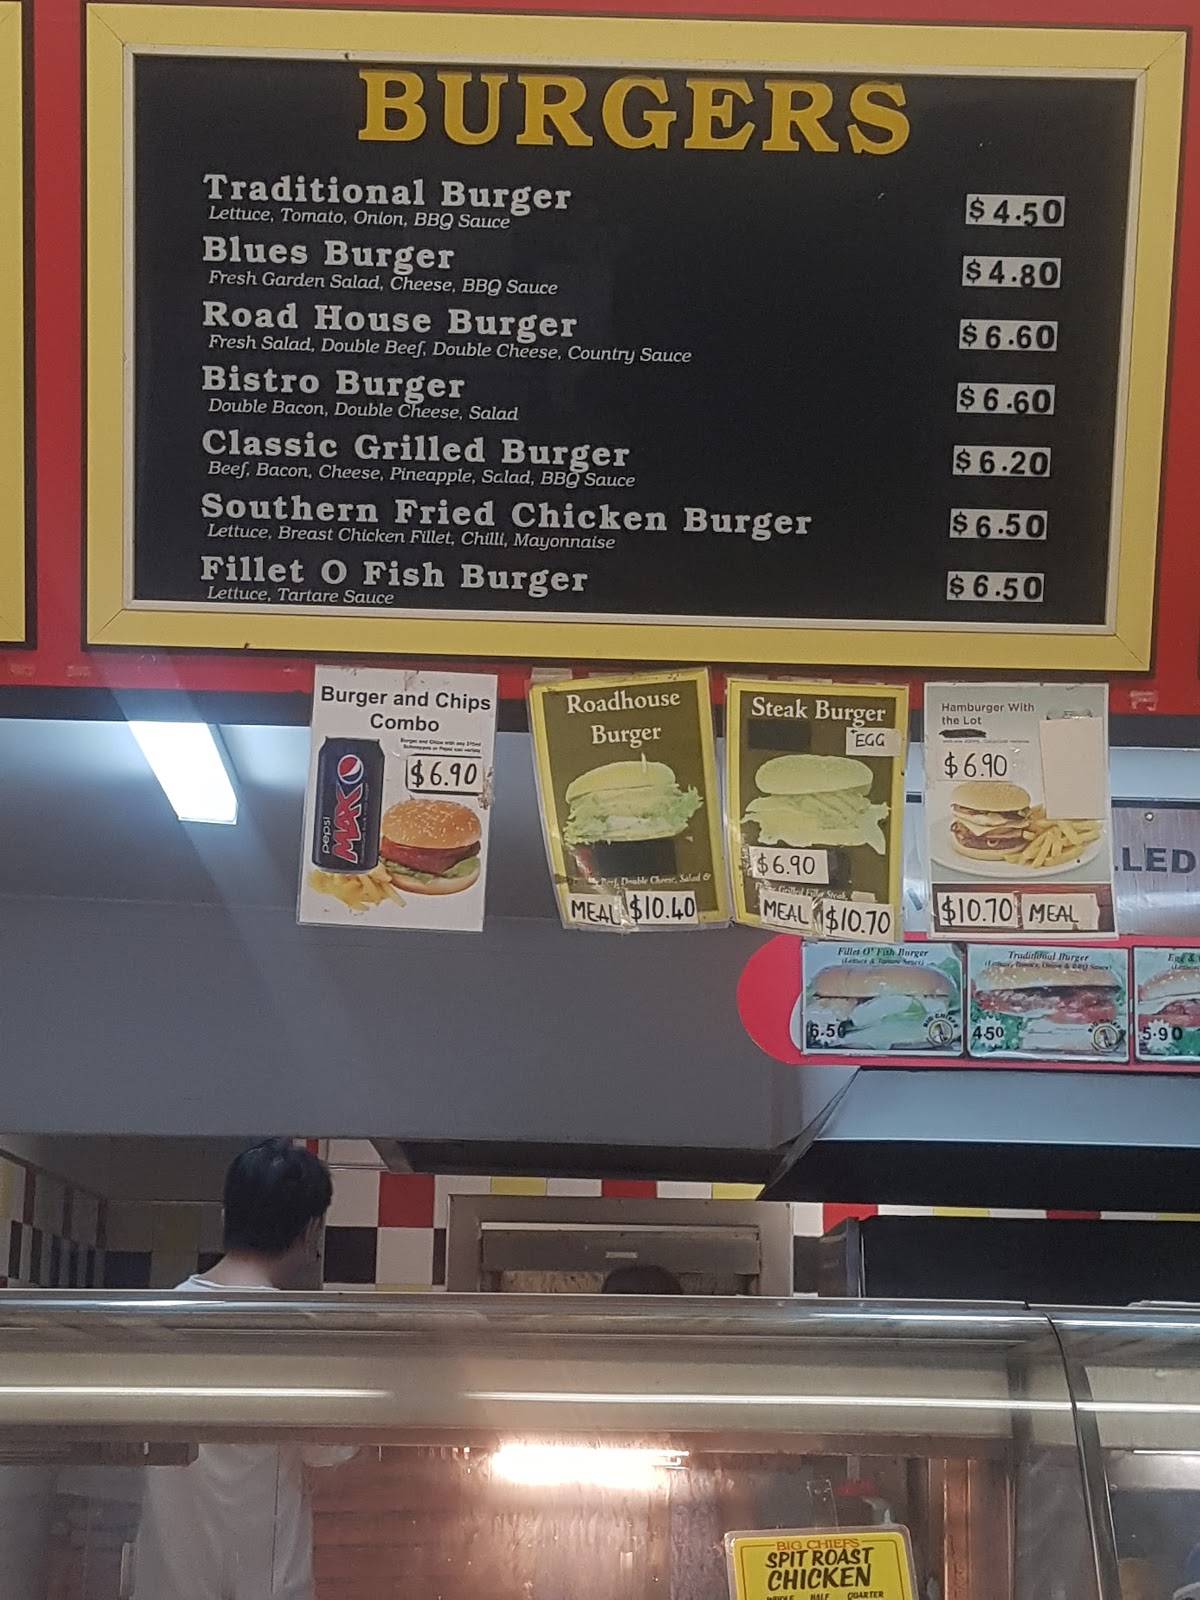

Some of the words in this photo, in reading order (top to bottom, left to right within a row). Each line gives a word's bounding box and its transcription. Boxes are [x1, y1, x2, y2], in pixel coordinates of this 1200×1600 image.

[358, 70, 909, 154] BURGERS
[203, 174, 424, 205] Traditional
[441, 181, 571, 216] Burger
[209, 206, 273, 223] Lettuce,
[281, 208, 347, 225] Tomato,
[354, 210, 407, 227] Onion,
[414, 212, 453, 230] BBQ
[458, 214, 510, 228] Sauce
[203, 236, 307, 264] Blues
[324, 240, 454, 275] Burger
[209, 270, 257, 285] Fresh
[262, 272, 325, 287] Garden
[330, 274, 383, 291] Salad,
[391, 277, 455, 293] Cheese,
[462, 278, 502, 296] BBQ
[506, 279, 558, 294] Sauce
[203, 301, 298, 328] Road
[314, 305, 431, 332] House
[448, 309, 577, 343] Burger
[209, 334, 256, 349] Fresh
[261, 336, 314, 352] Salad,
[321, 338, 379, 353] Double
[384, 340, 426, 358] Beef,
[432, 342, 491, 356] Double
[497, 344, 561, 360] Cheese,
[568, 346, 635, 364] Country
[640, 348, 692, 362] Sauce
[202, 365, 319, 393] Bistro
[336, 370, 465, 404] Burger
[208, 398, 267, 413] Double
[272, 400, 328, 416] Bacon,
[334, 402, 393, 417] Double
[398, 404, 462, 420] Cheese,
[469, 406, 519, 420] Salad
[203, 429, 337, 457] Classic
[355, 435, 485, 462] Grilled
[502, 439, 630, 473] Burger
[208, 461, 249, 479] Beef,
[256, 463, 312, 479] Bacon,
[319, 464, 383, 481] Cheese,
[390, 467, 475, 485] Pineapple,
[482, 469, 534, 486] Salad,
[540, 471, 580, 488] BBQ
[584, 473, 635, 487] Sauce
[202, 493, 378, 522] Southern
[395, 499, 495, 526] Fried
[512, 502, 667, 530] Chicken
[684, 508, 812, 540] Burger
[207, 524, 272, 539] Lettuce,
[278, 526, 333, 540] Breast
[338, 528, 405, 543] Chicken
[410, 530, 454, 546] Fillet,
[461, 532, 507, 547] Chilli,
[513, 533, 615, 550] Mayonnaise
[201, 556, 304, 583] Fillet
[322, 560, 347, 584] O
[363, 561, 444, 587] Fish
[461, 564, 588, 597] Burger
[208, 586, 270, 601] Lettuce,
[278, 588, 338, 602] Tartare
[344, 590, 394, 604] Sauce
[321, 686, 388, 708] Burger
[394, 691, 425, 705] and
[436, 692, 491, 712] Chips
[567, 689, 681, 714] Roadhouse
[941, 702, 1004, 713] Hamburger
[1008, 702, 1034, 712] With
[370, 713, 439, 733] Combo
[751, 697, 808, 720] Steak
[814, 699, 887, 728] Burger
[941, 715, 959, 725] the
[963, 716, 982, 725] Lot
[591, 724, 662, 749] Burger
[855, 733, 885, 748] EGG
[411, 759, 477, 788] $6.90
[944, 751, 1007, 778] $6.90
[322, 816, 331, 854] pepsi
[332, 782, 363, 864] MAX
[757, 852, 815, 876] $6.90
[1115, 847, 1196, 874] LED
[571, 900, 621, 926] MEAL
[629, 894, 696, 923] $10.40
[763, 899, 809, 925] MEAL
[826, 905, 891, 935] $10.70
[941, 895, 1013, 926] $10.70
[1029, 903, 1079, 924] MEAL
[838, 947, 860, 956] Fillet
[898, 948, 929, 959] Burger
[1008, 951, 1056, 960] Traditional
[1058, 951, 1089, 962] Burger
[766, 1550, 808, 1569] SPIT
[812, 1547, 874, 1567] ROAST
[777, 1541, 802, 1551] BIG
[767, 1563, 871, 1591] CHICKEN
